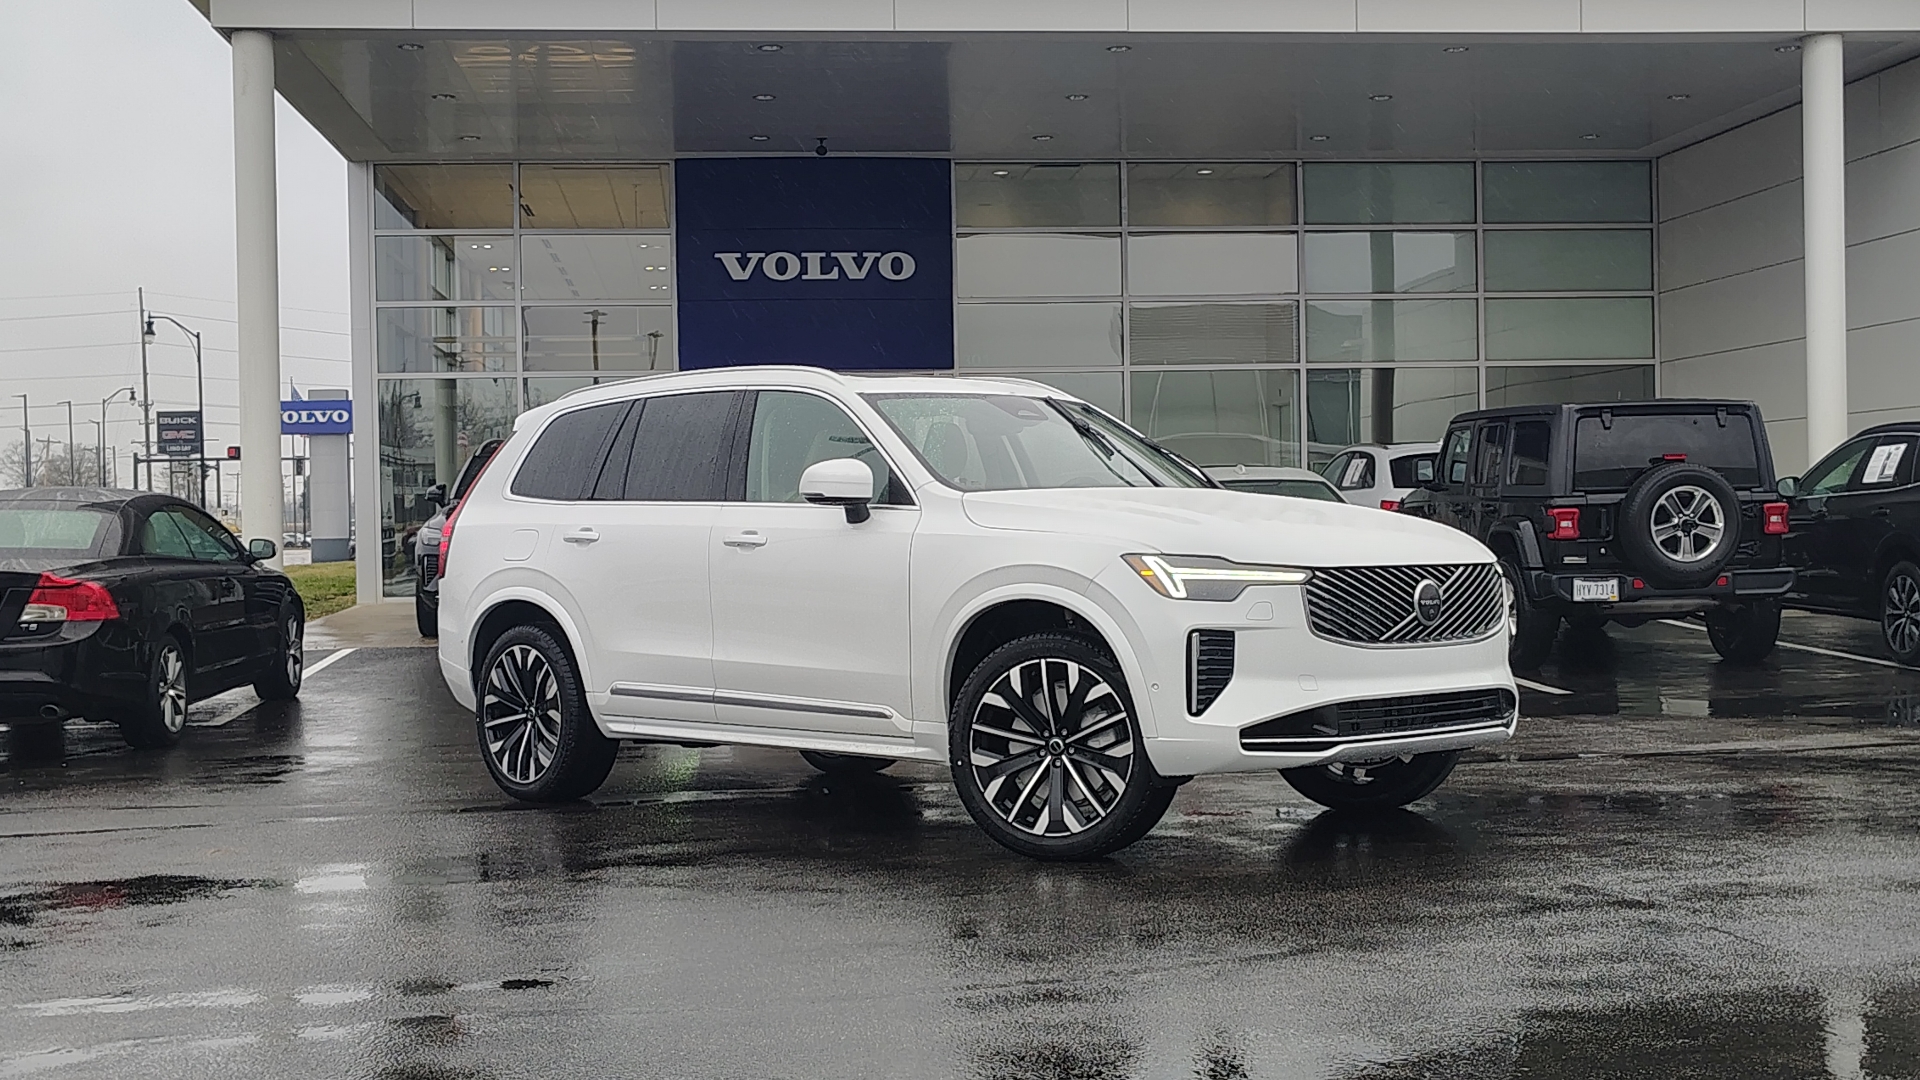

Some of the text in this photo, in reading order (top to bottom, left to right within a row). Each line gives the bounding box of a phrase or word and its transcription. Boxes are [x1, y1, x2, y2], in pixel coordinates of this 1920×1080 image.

[714, 251, 916, 281] VOLVO
[159, 416, 197, 425] BUICK
[280, 410, 349, 424] OLVO
[161, 430, 196, 440] GMC
